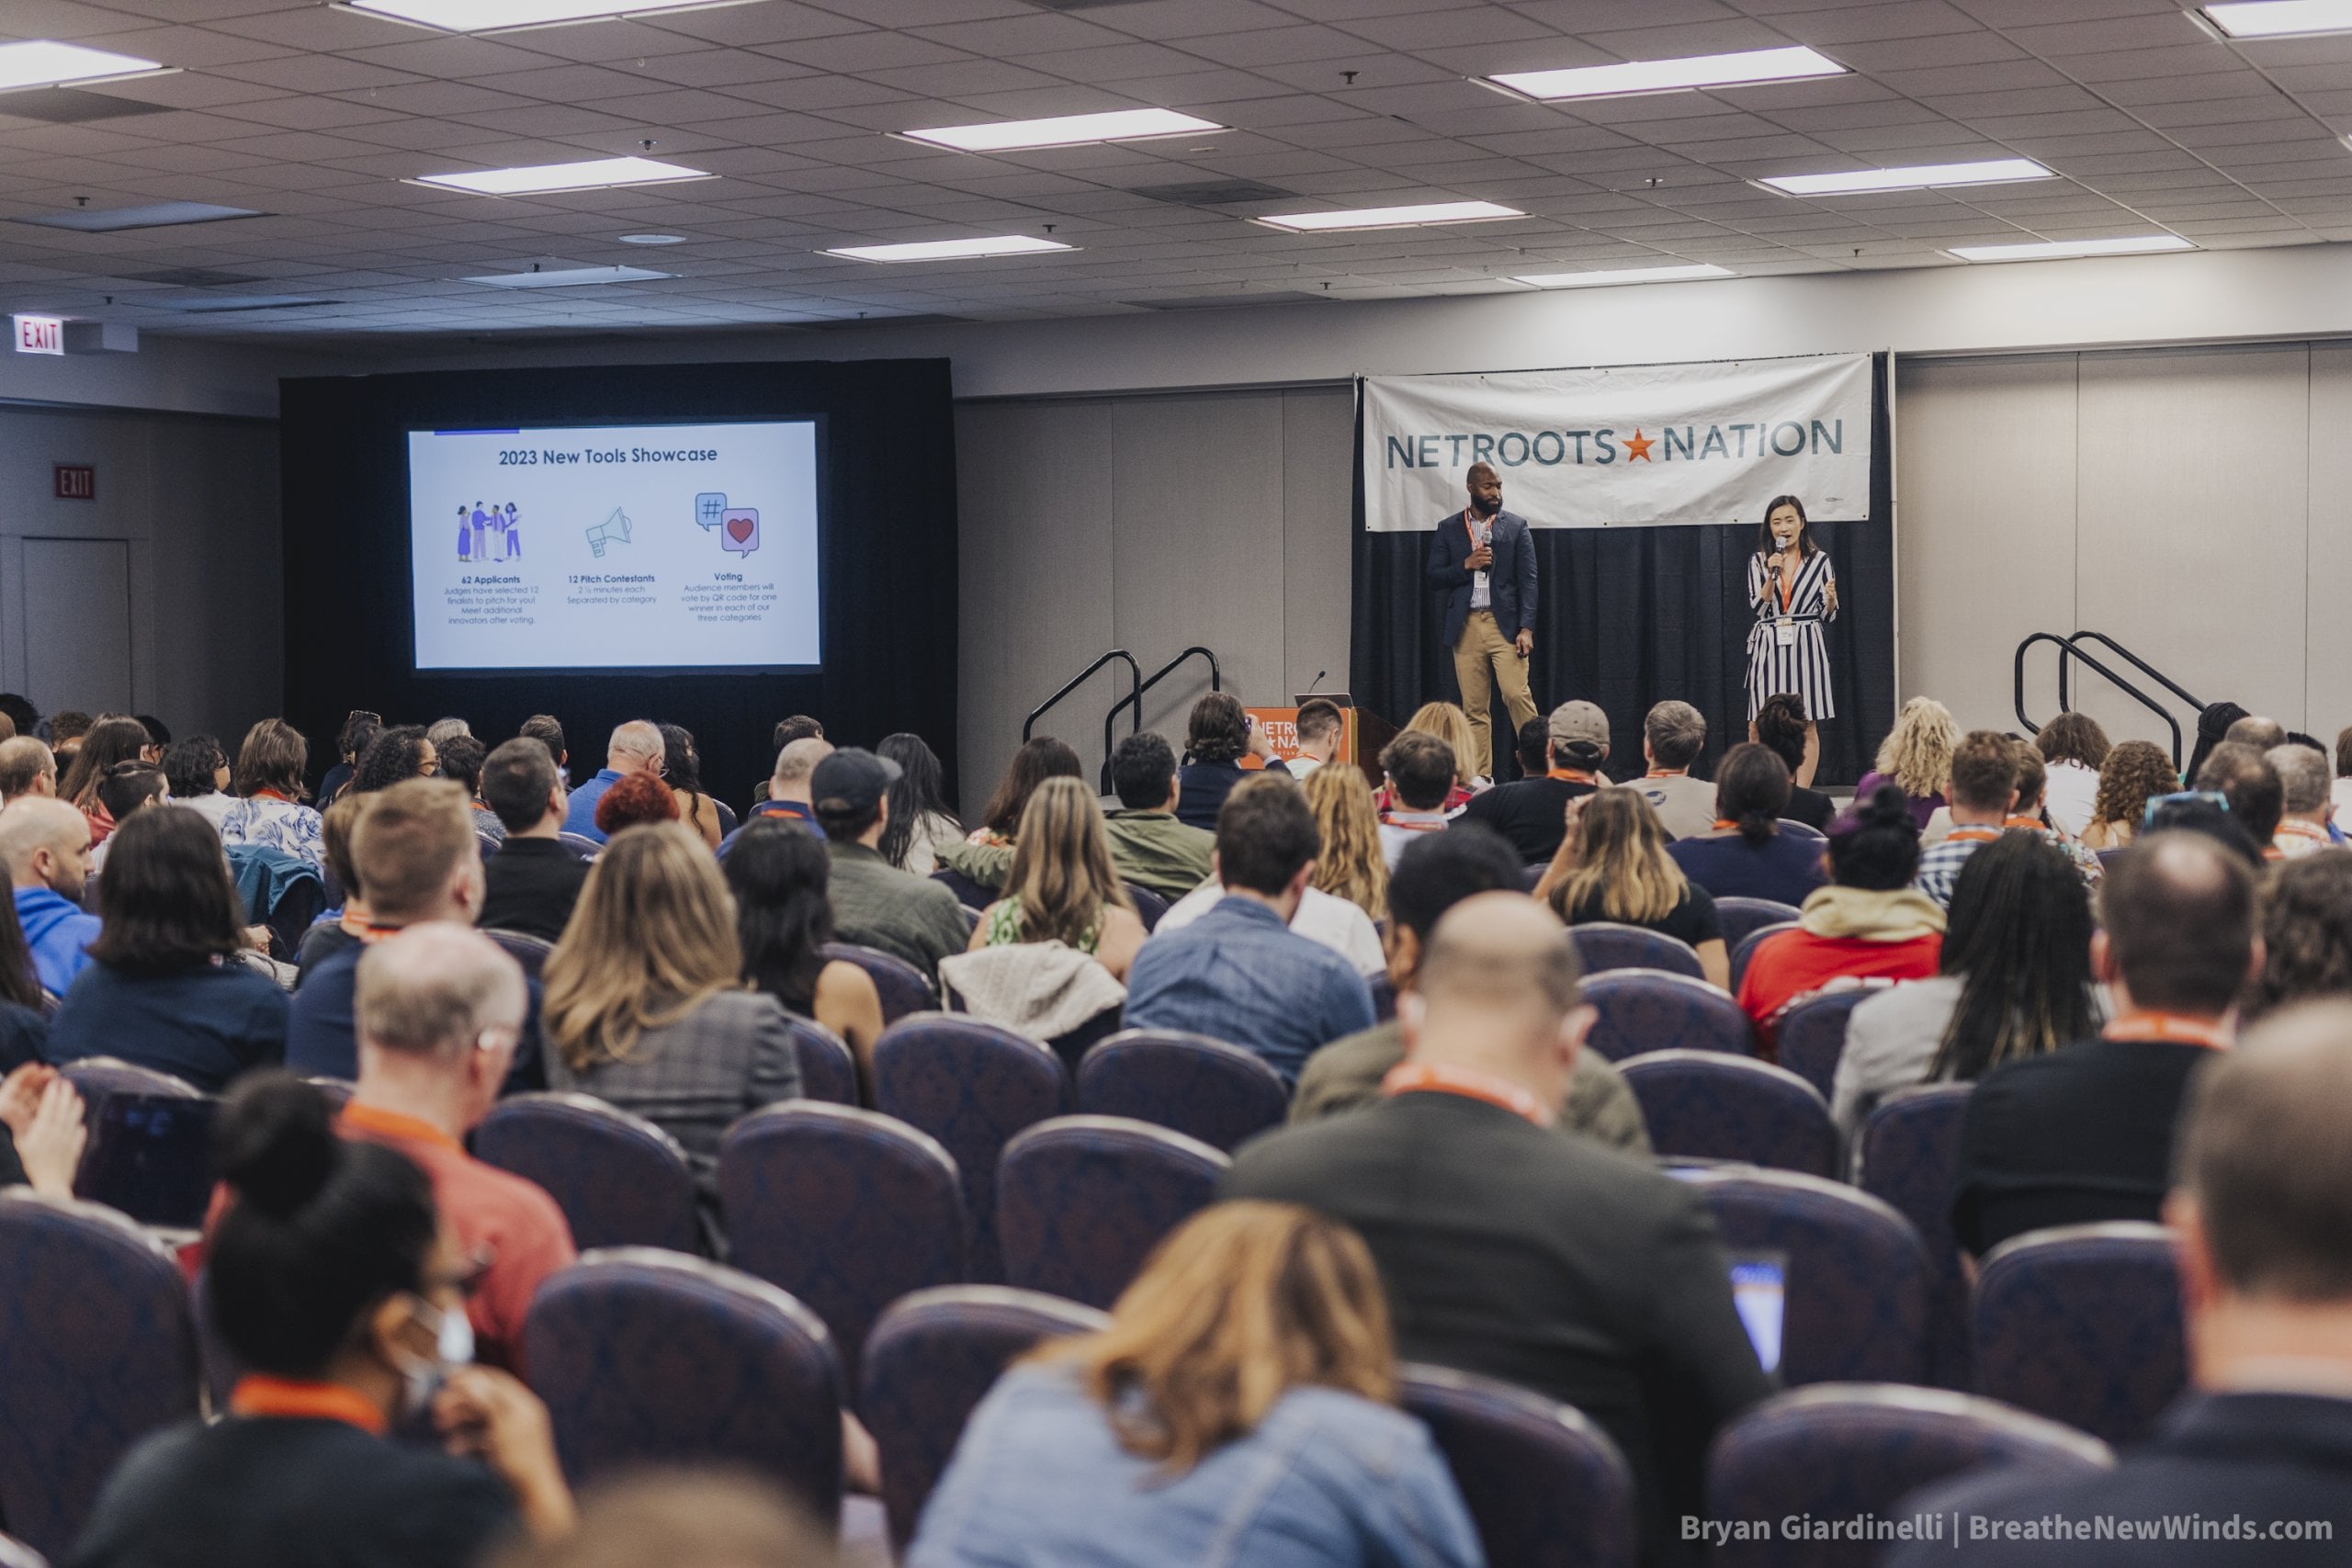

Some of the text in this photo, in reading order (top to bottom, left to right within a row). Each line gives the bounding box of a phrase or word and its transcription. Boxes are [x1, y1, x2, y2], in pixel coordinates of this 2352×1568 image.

[23, 321, 57, 349] EXIT
[1387, 419, 1843, 468] NETROOTS NATION
[499, 446, 718, 465] 2023 New Tools Showcase
[61, 469, 91, 496] EXIT
[461, 575, 521, 586] 62 Applicants
[569, 574, 655, 583] 12 Pitch Contestants
[714, 572, 742, 582] Voting
[444, 587, 471, 596] Judges
[494, 586, 528, 594] selected
[578, 586, 583, 594] 2
[625, 585, 646, 593] each
[762, 582, 775, 591] will
[447, 597, 474, 605] finalists
[485, 597, 505, 605] pitch
[567, 595, 657, 604] Separated by category
[700, 594, 710, 603] by
[712, 593, 724, 602] QR
[726, 593, 748, 602] code
[483, 606, 523, 615] additional
[724, 604, 746, 612] each
[747, 603, 755, 611] of
[719, 614, 763, 623] categories
